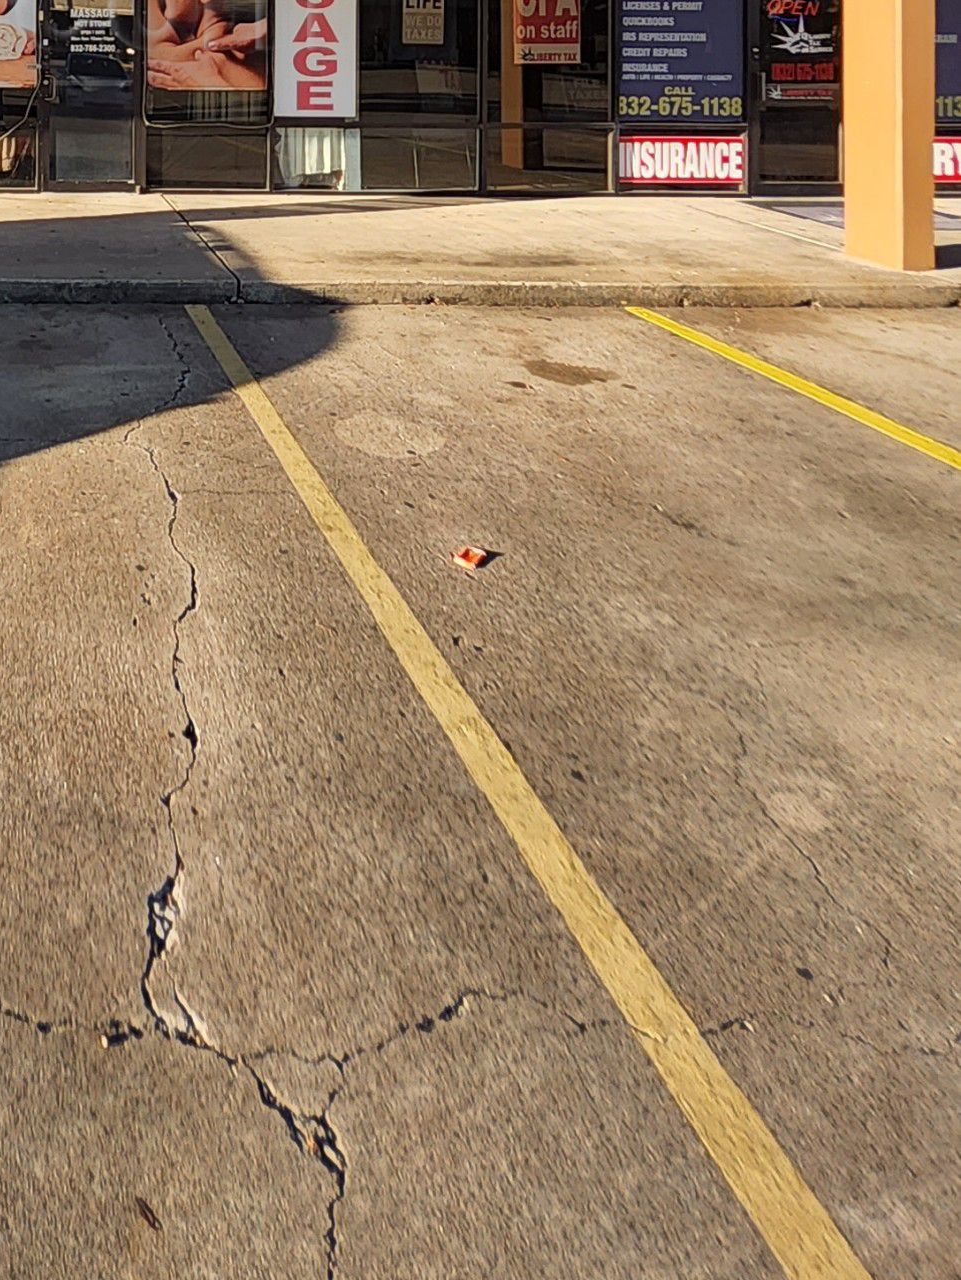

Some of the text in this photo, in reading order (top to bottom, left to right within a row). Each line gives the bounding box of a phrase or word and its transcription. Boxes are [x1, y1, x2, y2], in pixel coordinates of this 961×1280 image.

[622, 1, 661, 10] LICENSES
[672, 2, 702, 10] PERMIT
[70, 8, 116, 18] MASSAGE
[405, 15, 441, 27] WE DO
[622, 17, 675, 26] QUICKBOOKS
[404, 28, 440, 40] TAXES
[516, 21, 578, 39] on staff
[622, 32, 636, 41] IRS
[533, 53, 577, 61] LIBERTY TAX
[622, 48, 687, 57] CREDIT REPAIRS
[622, 63, 669, 72] INSURANCE
[664, 86, 696, 95] CALL
[619, 96, 742, 116] 832-675-1138
[619, 141, 743, 179] INSURANCE
